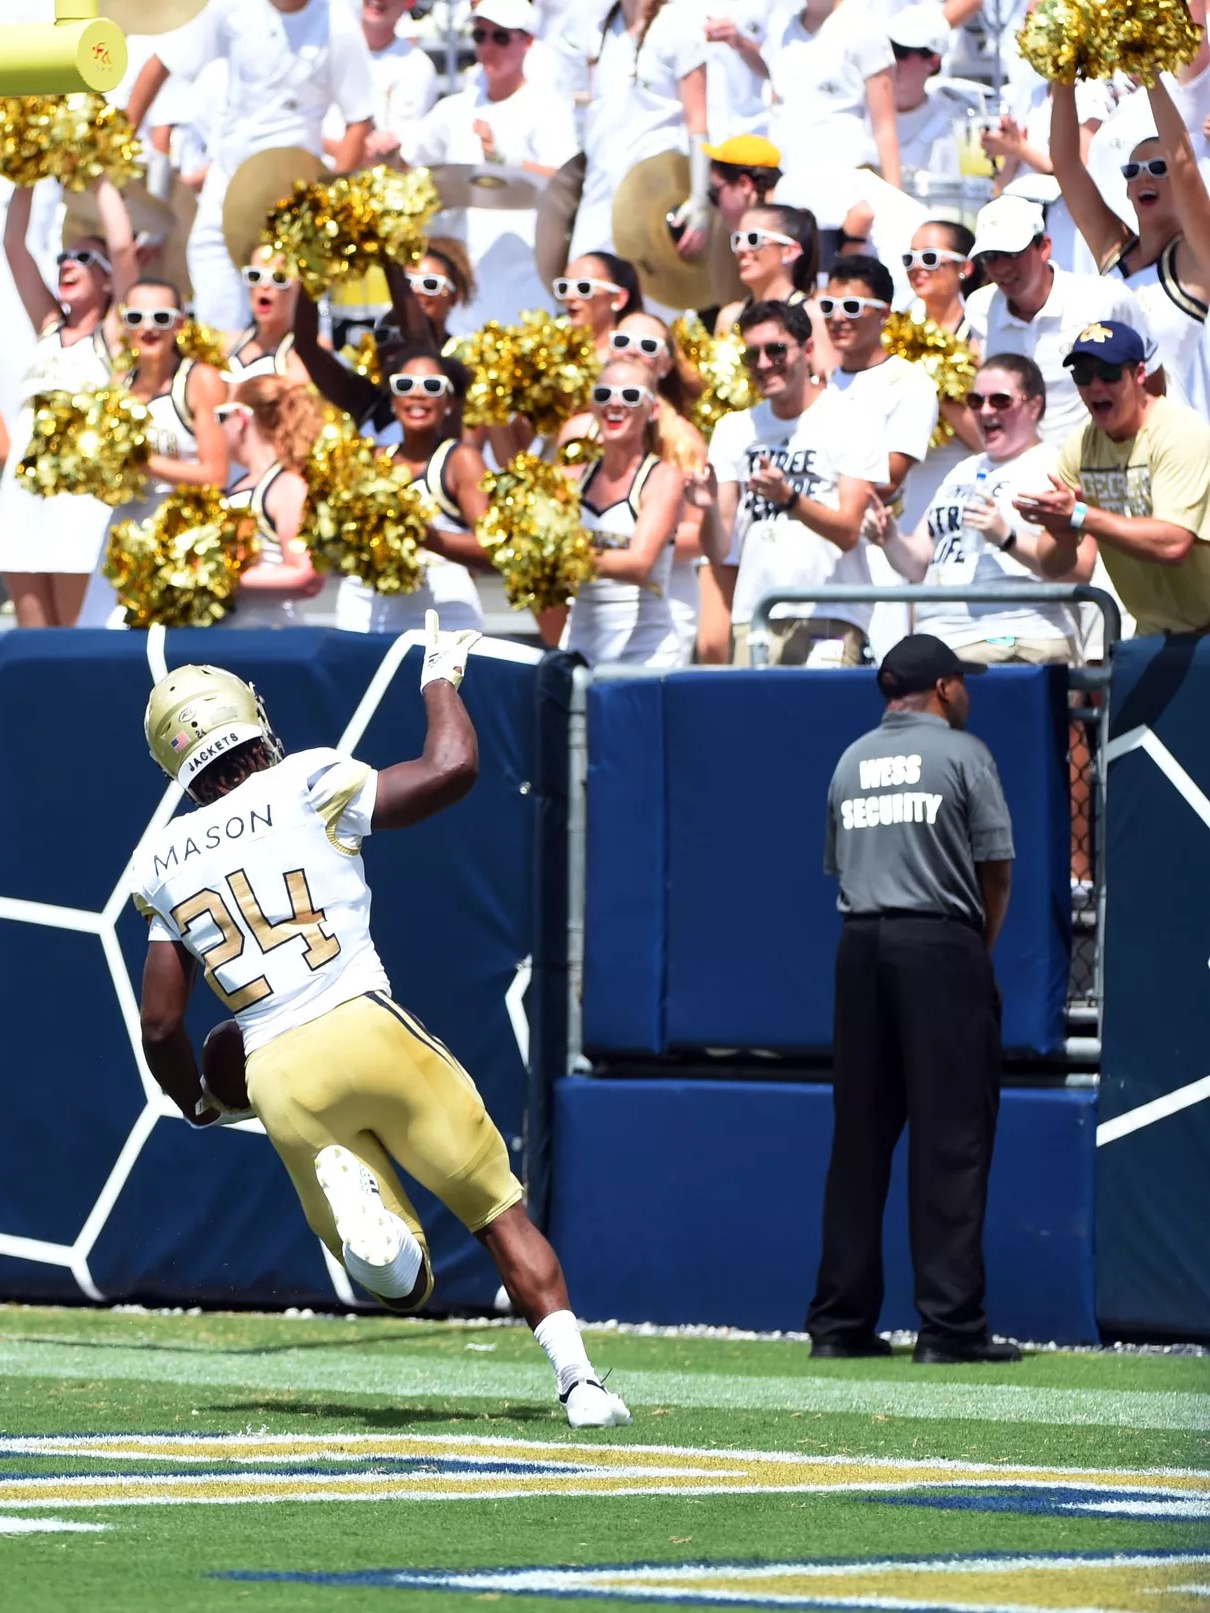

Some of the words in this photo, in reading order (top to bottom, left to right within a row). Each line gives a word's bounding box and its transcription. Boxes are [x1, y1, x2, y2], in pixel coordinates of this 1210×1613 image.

[188, 732, 239, 773] JACKETS
[859, 754, 923, 790] WESS
[840, 791, 943, 831] SECURITY
[152, 804, 273, 877] MASON
[169, 867, 342, 1014] 24
